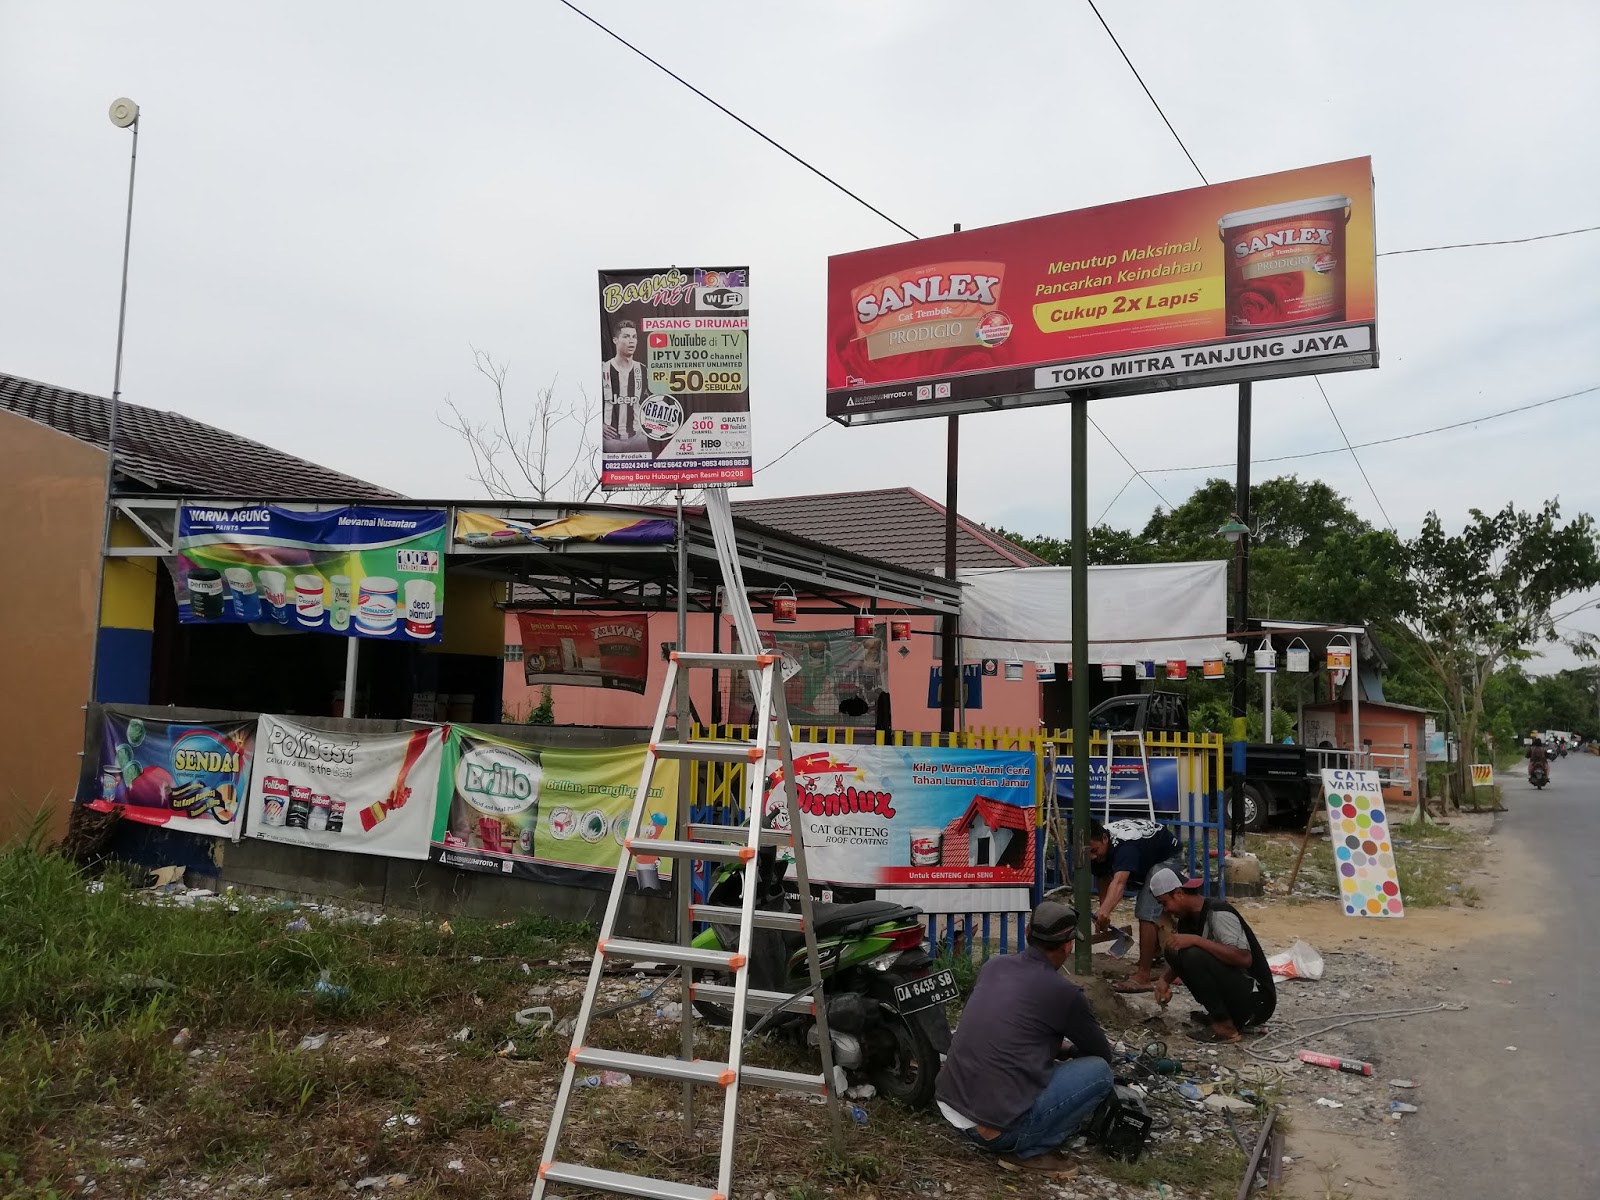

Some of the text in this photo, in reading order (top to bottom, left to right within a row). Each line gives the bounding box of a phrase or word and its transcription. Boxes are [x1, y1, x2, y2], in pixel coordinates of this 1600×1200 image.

[1234, 228, 1332, 259] SANLEX
[1047, 238, 1202, 275] Menutup Maksimal,
[1257, 256, 1310, 271] PRODIGIO
[694, 268, 746, 287] HOME
[1035, 261, 1202, 296] Pancarkan Keindahan
[857, 273, 999, 324] SANLEX
[898, 306, 952, 322] Cat Tembok
[1050, 304, 1107, 323] Cukup
[1112, 295, 1142, 314] 2x
[645, 319, 748, 329] PASANG DIRUMAH
[888, 322, 962, 345] PRODIGIO
[669, 334, 739, 347] YouTube di TV
[653, 351, 680, 360] IPTV
[684, 350, 708, 360] 300
[1051, 334, 1349, 383] TOKO MITRA TANJUNG JAYA
[653, 371, 668, 381] RP.
[610, 394, 637, 406] Jeep
[645, 402, 678, 422] GRATIS
[692, 421, 713, 430] 300
[679, 443, 693, 451] 45
[701, 440, 721, 448] HBO
[190, 510, 270, 522] WARNA AGUNG
[377, 517, 417, 528] Nusantara
[413, 600, 430, 609] deco
[267, 724, 361, 764] Polibest
[175, 748, 240, 772] SENDAI
[308, 762, 316, 773] is
[317, 763, 331, 776] the
[913, 763, 1030, 775] Kilap Warna-Warni Ceria
[1334, 770, 1366, 781] CAT
[464, 762, 531, 800] Brillo
[913, 776, 1030, 788] Tahan Lumut dan Jamur
[1329, 781, 1379, 792] VARIASI
[546, 779, 664, 799] Brillan, mengilapan!
[810, 824, 889, 837] CAT GENTENG
[825, 836, 888, 846] ROOF COATING
[897, 972, 952, 1001] DA 6455 SB
